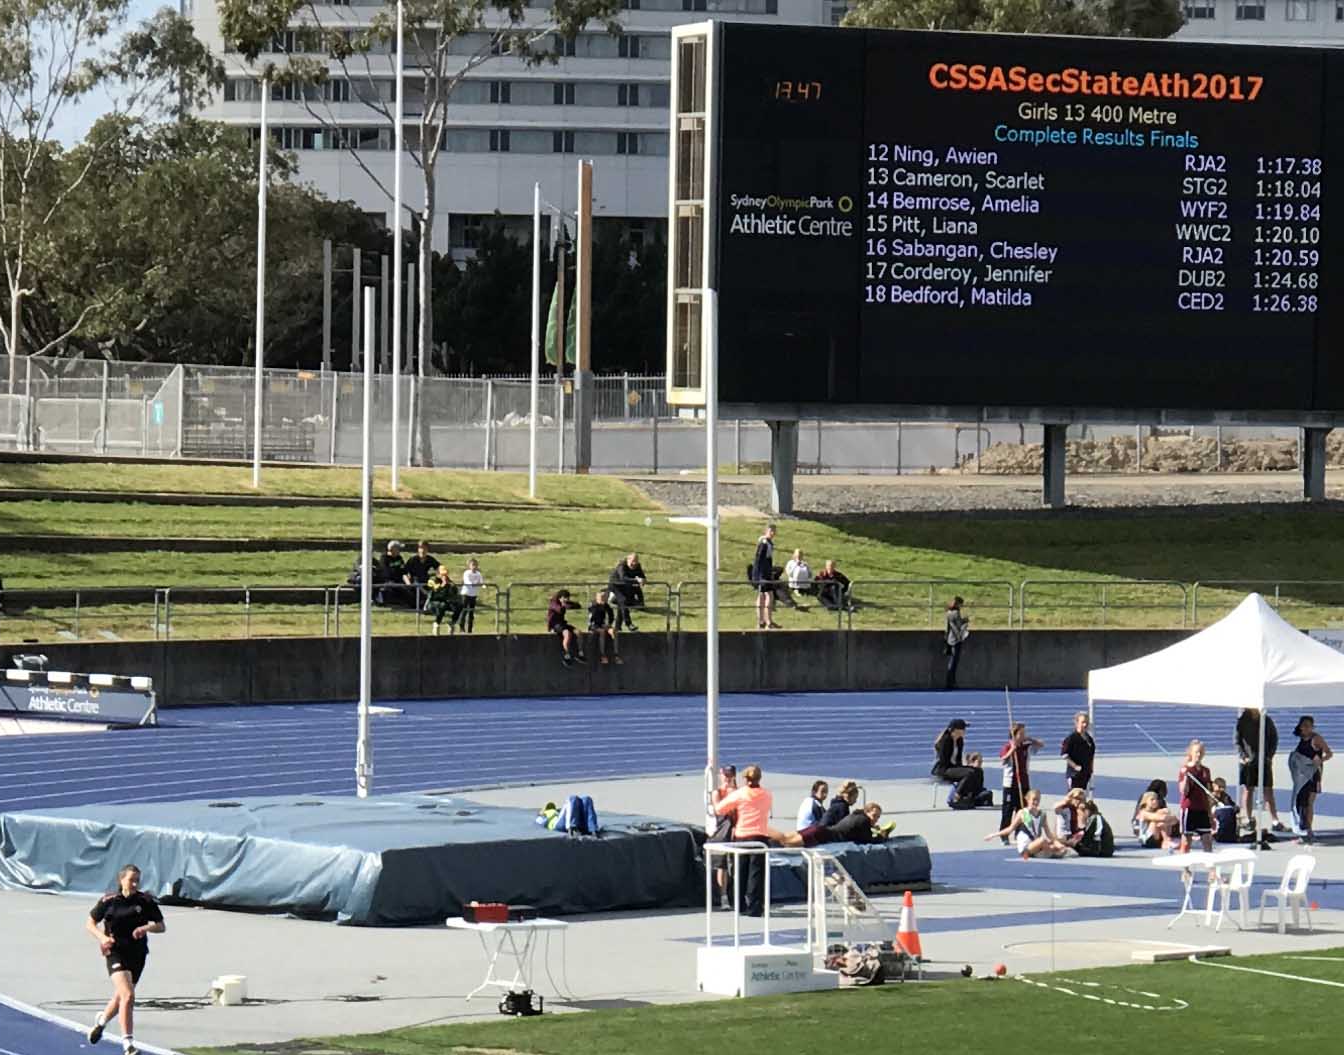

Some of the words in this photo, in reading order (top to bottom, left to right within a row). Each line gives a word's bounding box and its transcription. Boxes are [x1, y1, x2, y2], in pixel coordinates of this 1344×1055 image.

[928, 63, 1264, 101] CSSASecStateAth2017
[1018, 102, 1058, 121] Girls
[1064, 104, 1085, 122] 13
[1090, 105, 1123, 123] 400
[1129, 107, 1177, 125] Metre
[994, 125, 1078, 147] Complete
[1082, 128, 1145, 147] Results
[1151, 130, 1199, 149] Finals
[867, 144, 889, 161] 12
[894, 145, 939, 167] Ning,
[945, 147, 998, 165] Awien
[1185, 155, 1226, 172] RJA2
[1257, 157, 1322, 175] 1:17.38
[867, 168, 889, 185] 13
[892, 168, 979, 192] Cameron,
[985, 171, 1045, 190] Scarlet
[1182, 178, 1228, 195] STG2
[1256, 180, 1321, 198] 1:18.04
[866, 191, 889, 209] 14
[892, 192, 976, 215] Bemrose,
[981, 195, 1040, 213] Amelia
[1180, 200, 1228, 219] WYF2
[1255, 203, 1321, 221] 1:19.84
[730, 213, 797, 235] Athletic
[798, 215, 853, 237] Centre
[866, 215, 887, 232] 15
[892, 215, 926, 237] Pitt,
[932, 217, 978, 235] Liana
[1176, 223, 1232, 241] WWC2
[1254, 226, 1320, 244] 1:20.10
[865, 239, 887, 256] 16
[891, 239, 984, 262] Sabangan,
[990, 242, 1058, 264] Chesley
[1182, 246, 1224, 264] RJA2
[1254, 249, 1319, 267] 1:20.59
[865, 262, 887, 279] 17
[890, 262, 978, 285] Corderoy,
[984, 264, 1053, 283] Jennifer
[1178, 270, 1226, 287] DUB2
[1253, 271, 1319, 289] 1:24.68
[864, 285, 886, 302] 18
[890, 285, 965, 309] Bedford,
[971, 287, 1032, 306] Matilda
[1178, 292, 1225, 310] CED2
[1252, 294, 1318, 312] 1:26.38
[28, 695, 67, 713] Athletic
[67, 698, 100, 715] Centre
